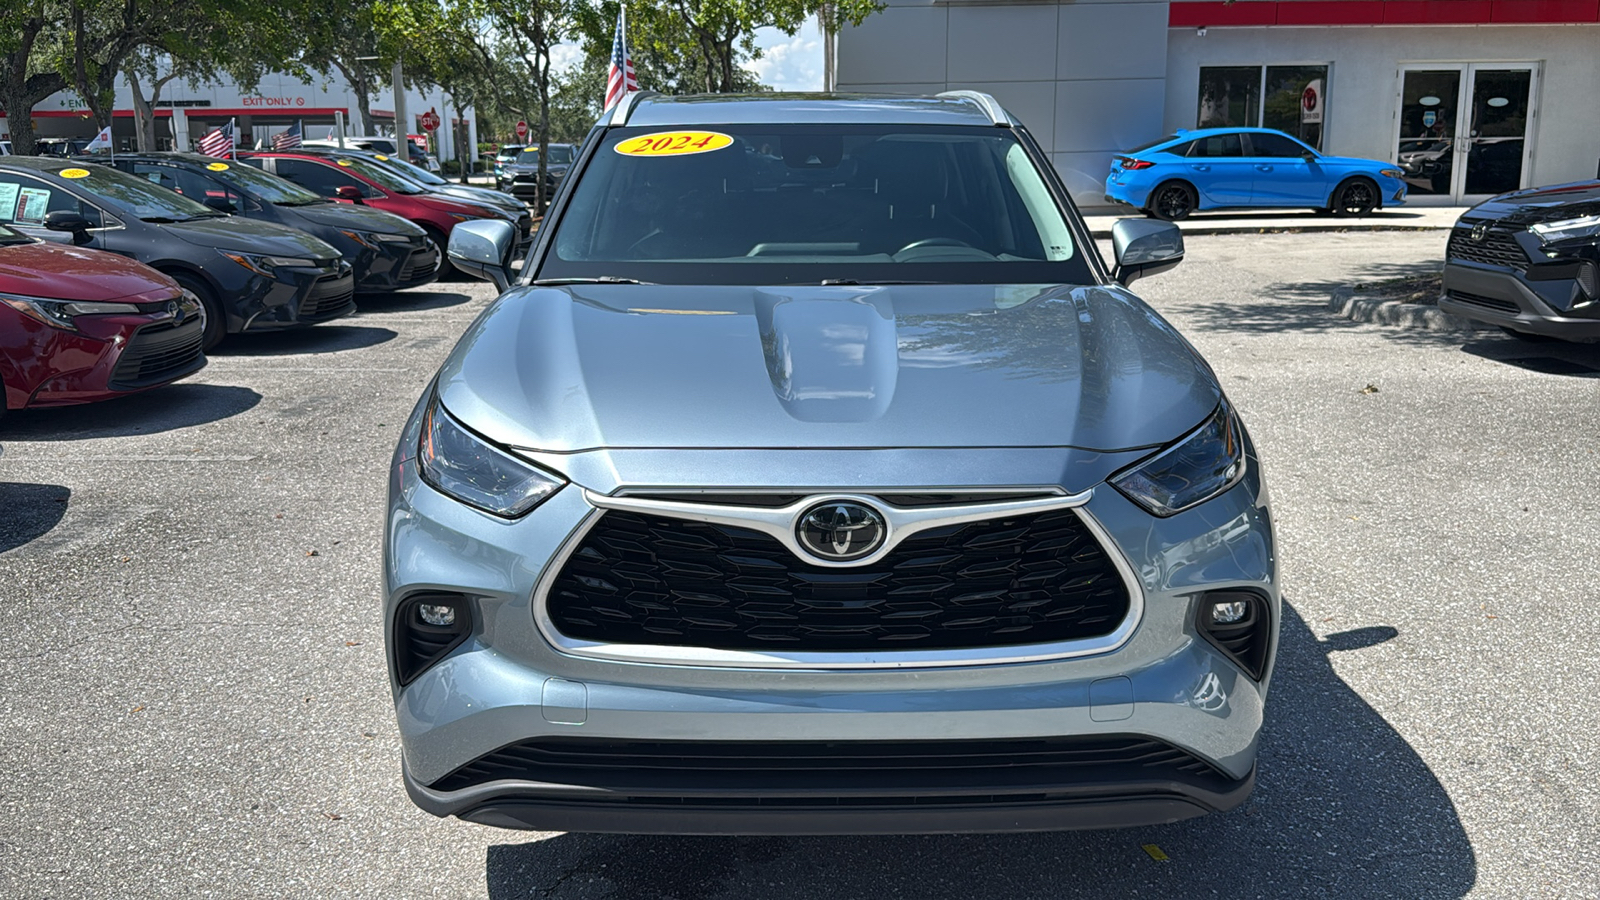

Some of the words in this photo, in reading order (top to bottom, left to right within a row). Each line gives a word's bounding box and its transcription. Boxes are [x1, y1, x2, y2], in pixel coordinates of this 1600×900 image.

[242, 97, 264, 106] EXIT
[266, 97, 292, 106] ONLY
[631, 135, 715, 153] 2024
